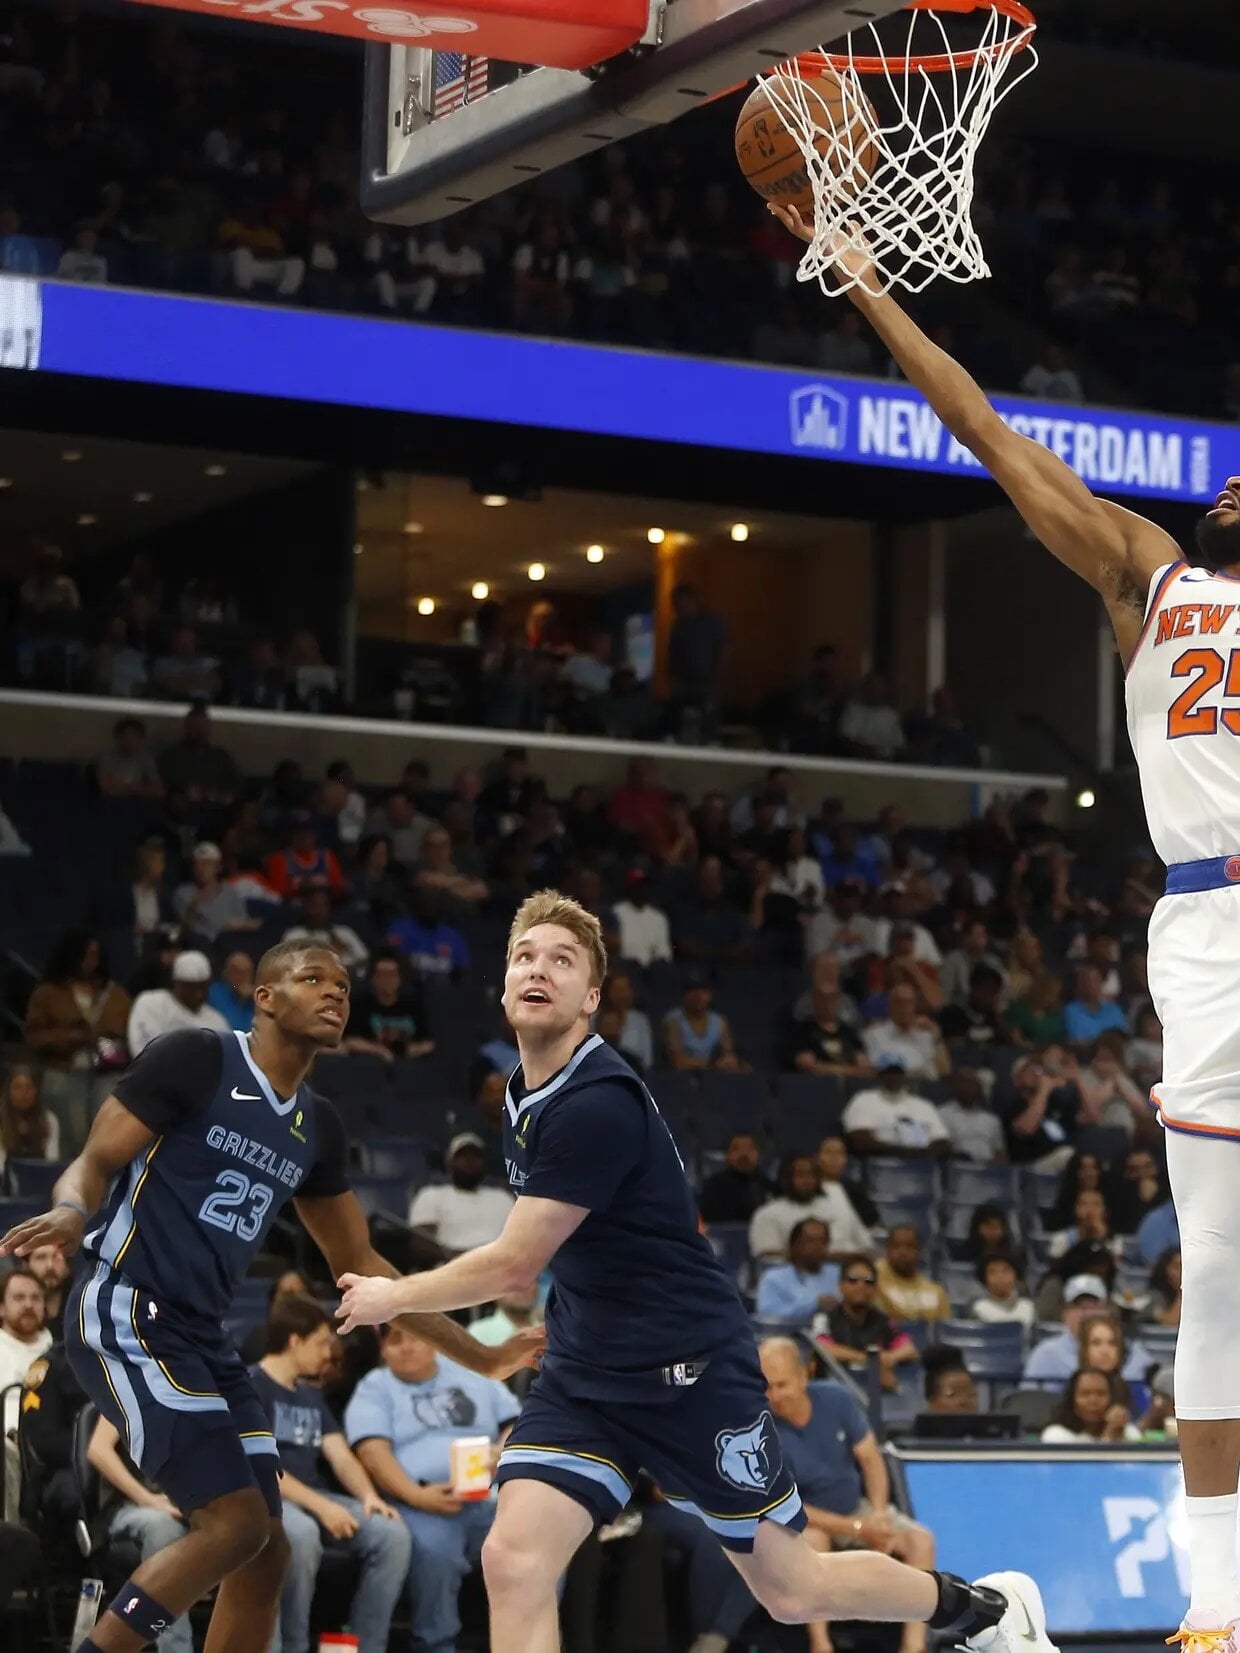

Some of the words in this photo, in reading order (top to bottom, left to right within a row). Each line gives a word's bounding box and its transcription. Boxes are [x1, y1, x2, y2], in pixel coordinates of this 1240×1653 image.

[858, 396, 942, 462] NEW
[947, 413, 1181, 491] ATERDAM
[1154, 604, 1235, 648] NEW
[206, 1125, 303, 1188] GRIZZLIES
[198, 1169, 274, 1241] 23
